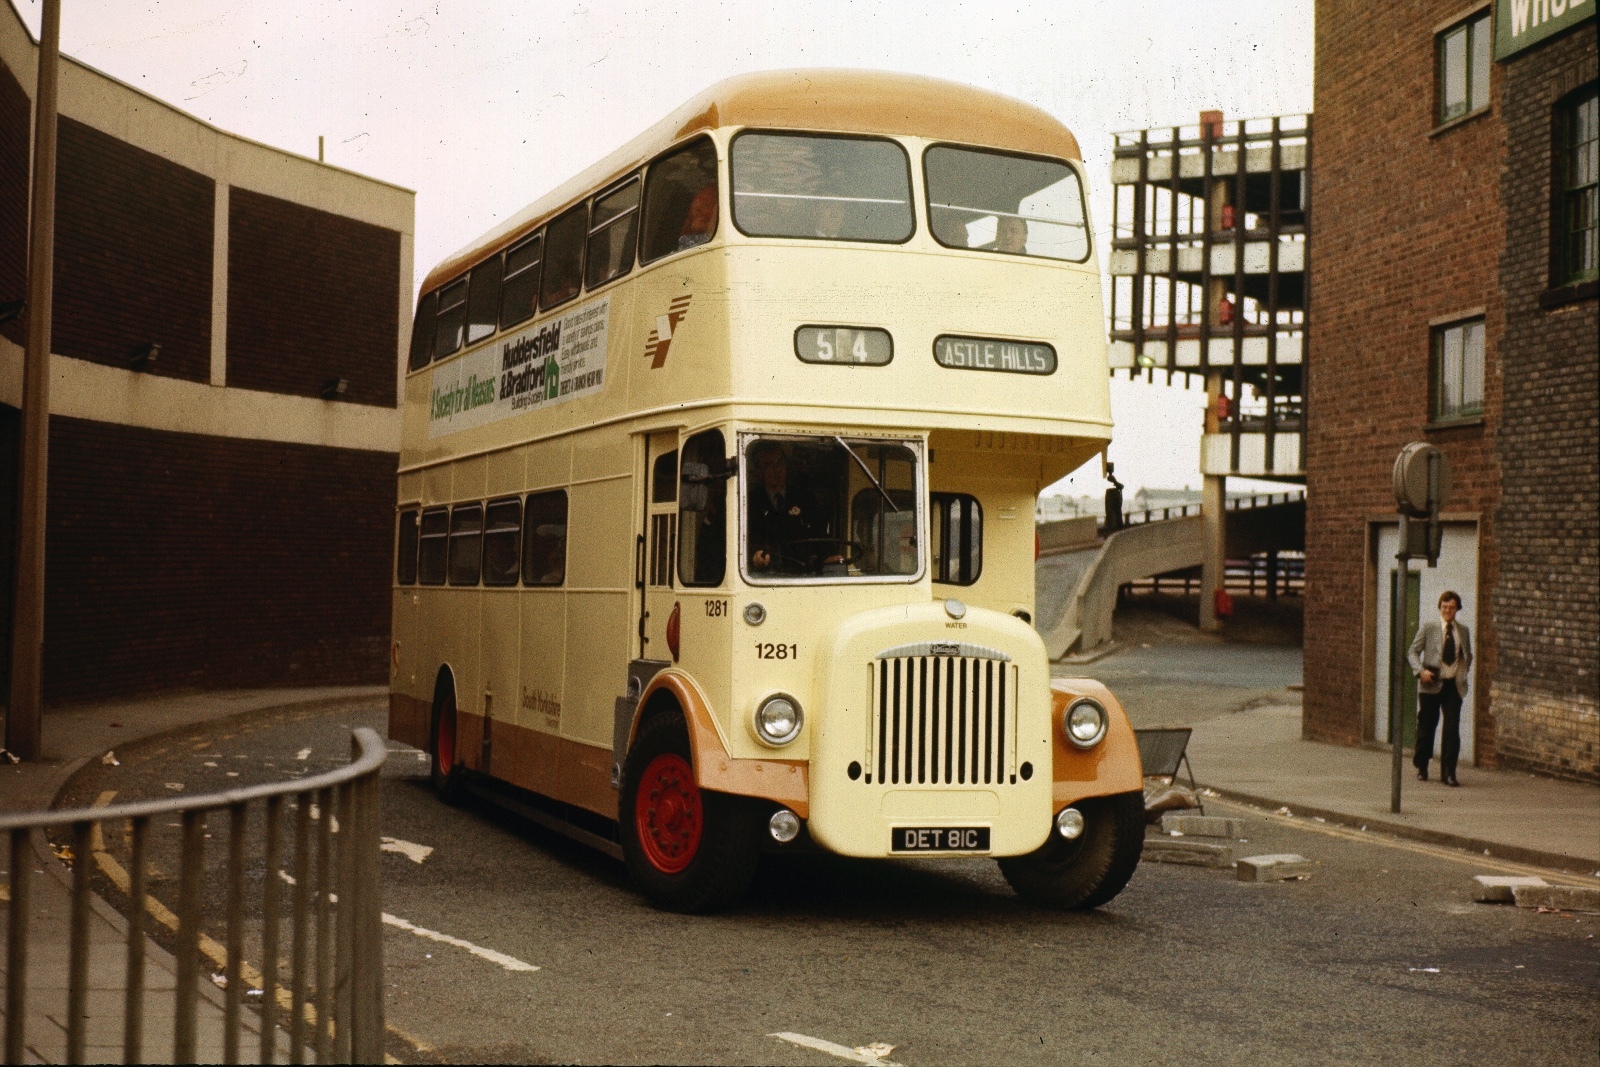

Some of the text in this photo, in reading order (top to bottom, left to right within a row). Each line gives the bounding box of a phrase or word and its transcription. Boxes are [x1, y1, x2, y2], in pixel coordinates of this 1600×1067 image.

[502, 321, 561, 371] Huddersfield
[1000, 345, 1046, 370] HILLS
[435, 385, 455, 422] Society
[454, 380, 464, 414] for
[472, 374, 496, 408] Reasons
[705, 600, 728, 617] 1281
[755, 643, 797, 660] 1281
[905, 830, 978, 848] DET 81C
